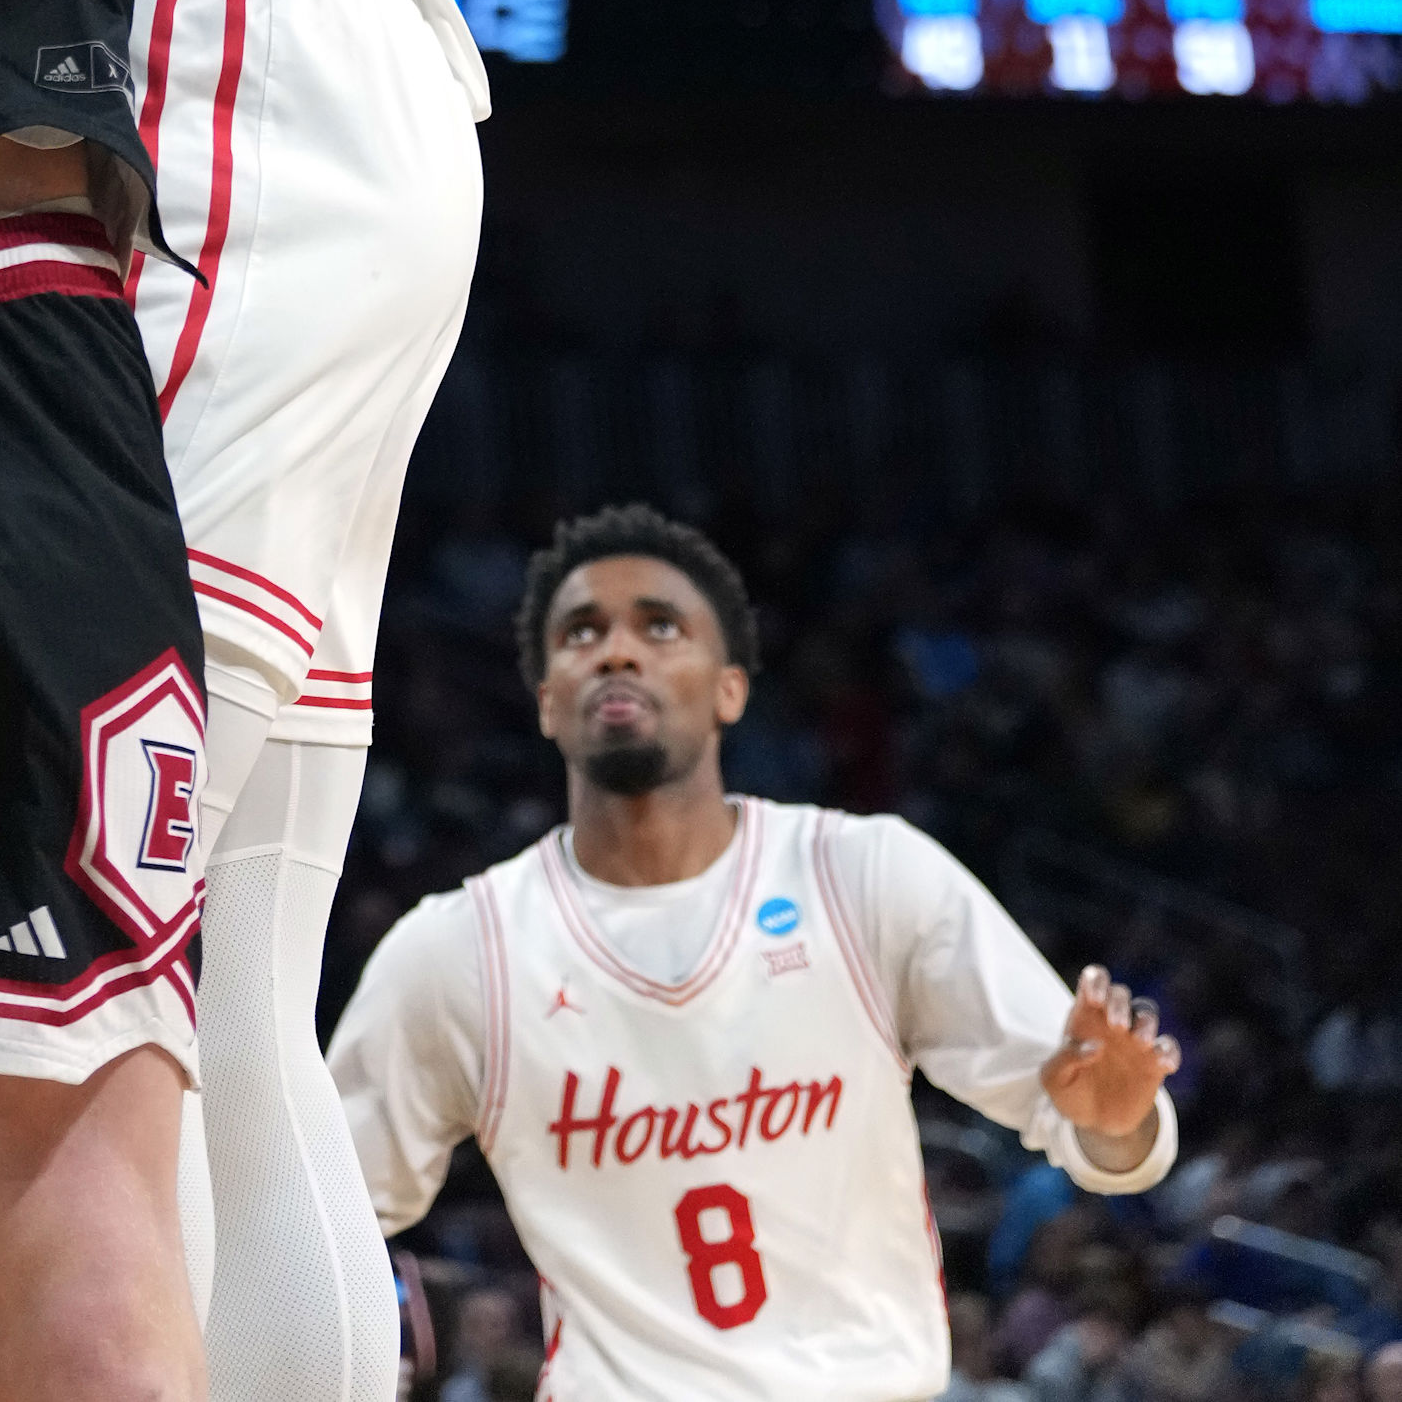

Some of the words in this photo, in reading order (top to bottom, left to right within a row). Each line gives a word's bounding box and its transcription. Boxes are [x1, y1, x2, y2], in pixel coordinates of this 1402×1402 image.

[43, 72, 87, 83] adidas
[136, 738, 197, 874] E
[549, 1065, 843, 1172] Houston
[675, 1184, 769, 1330] 8
